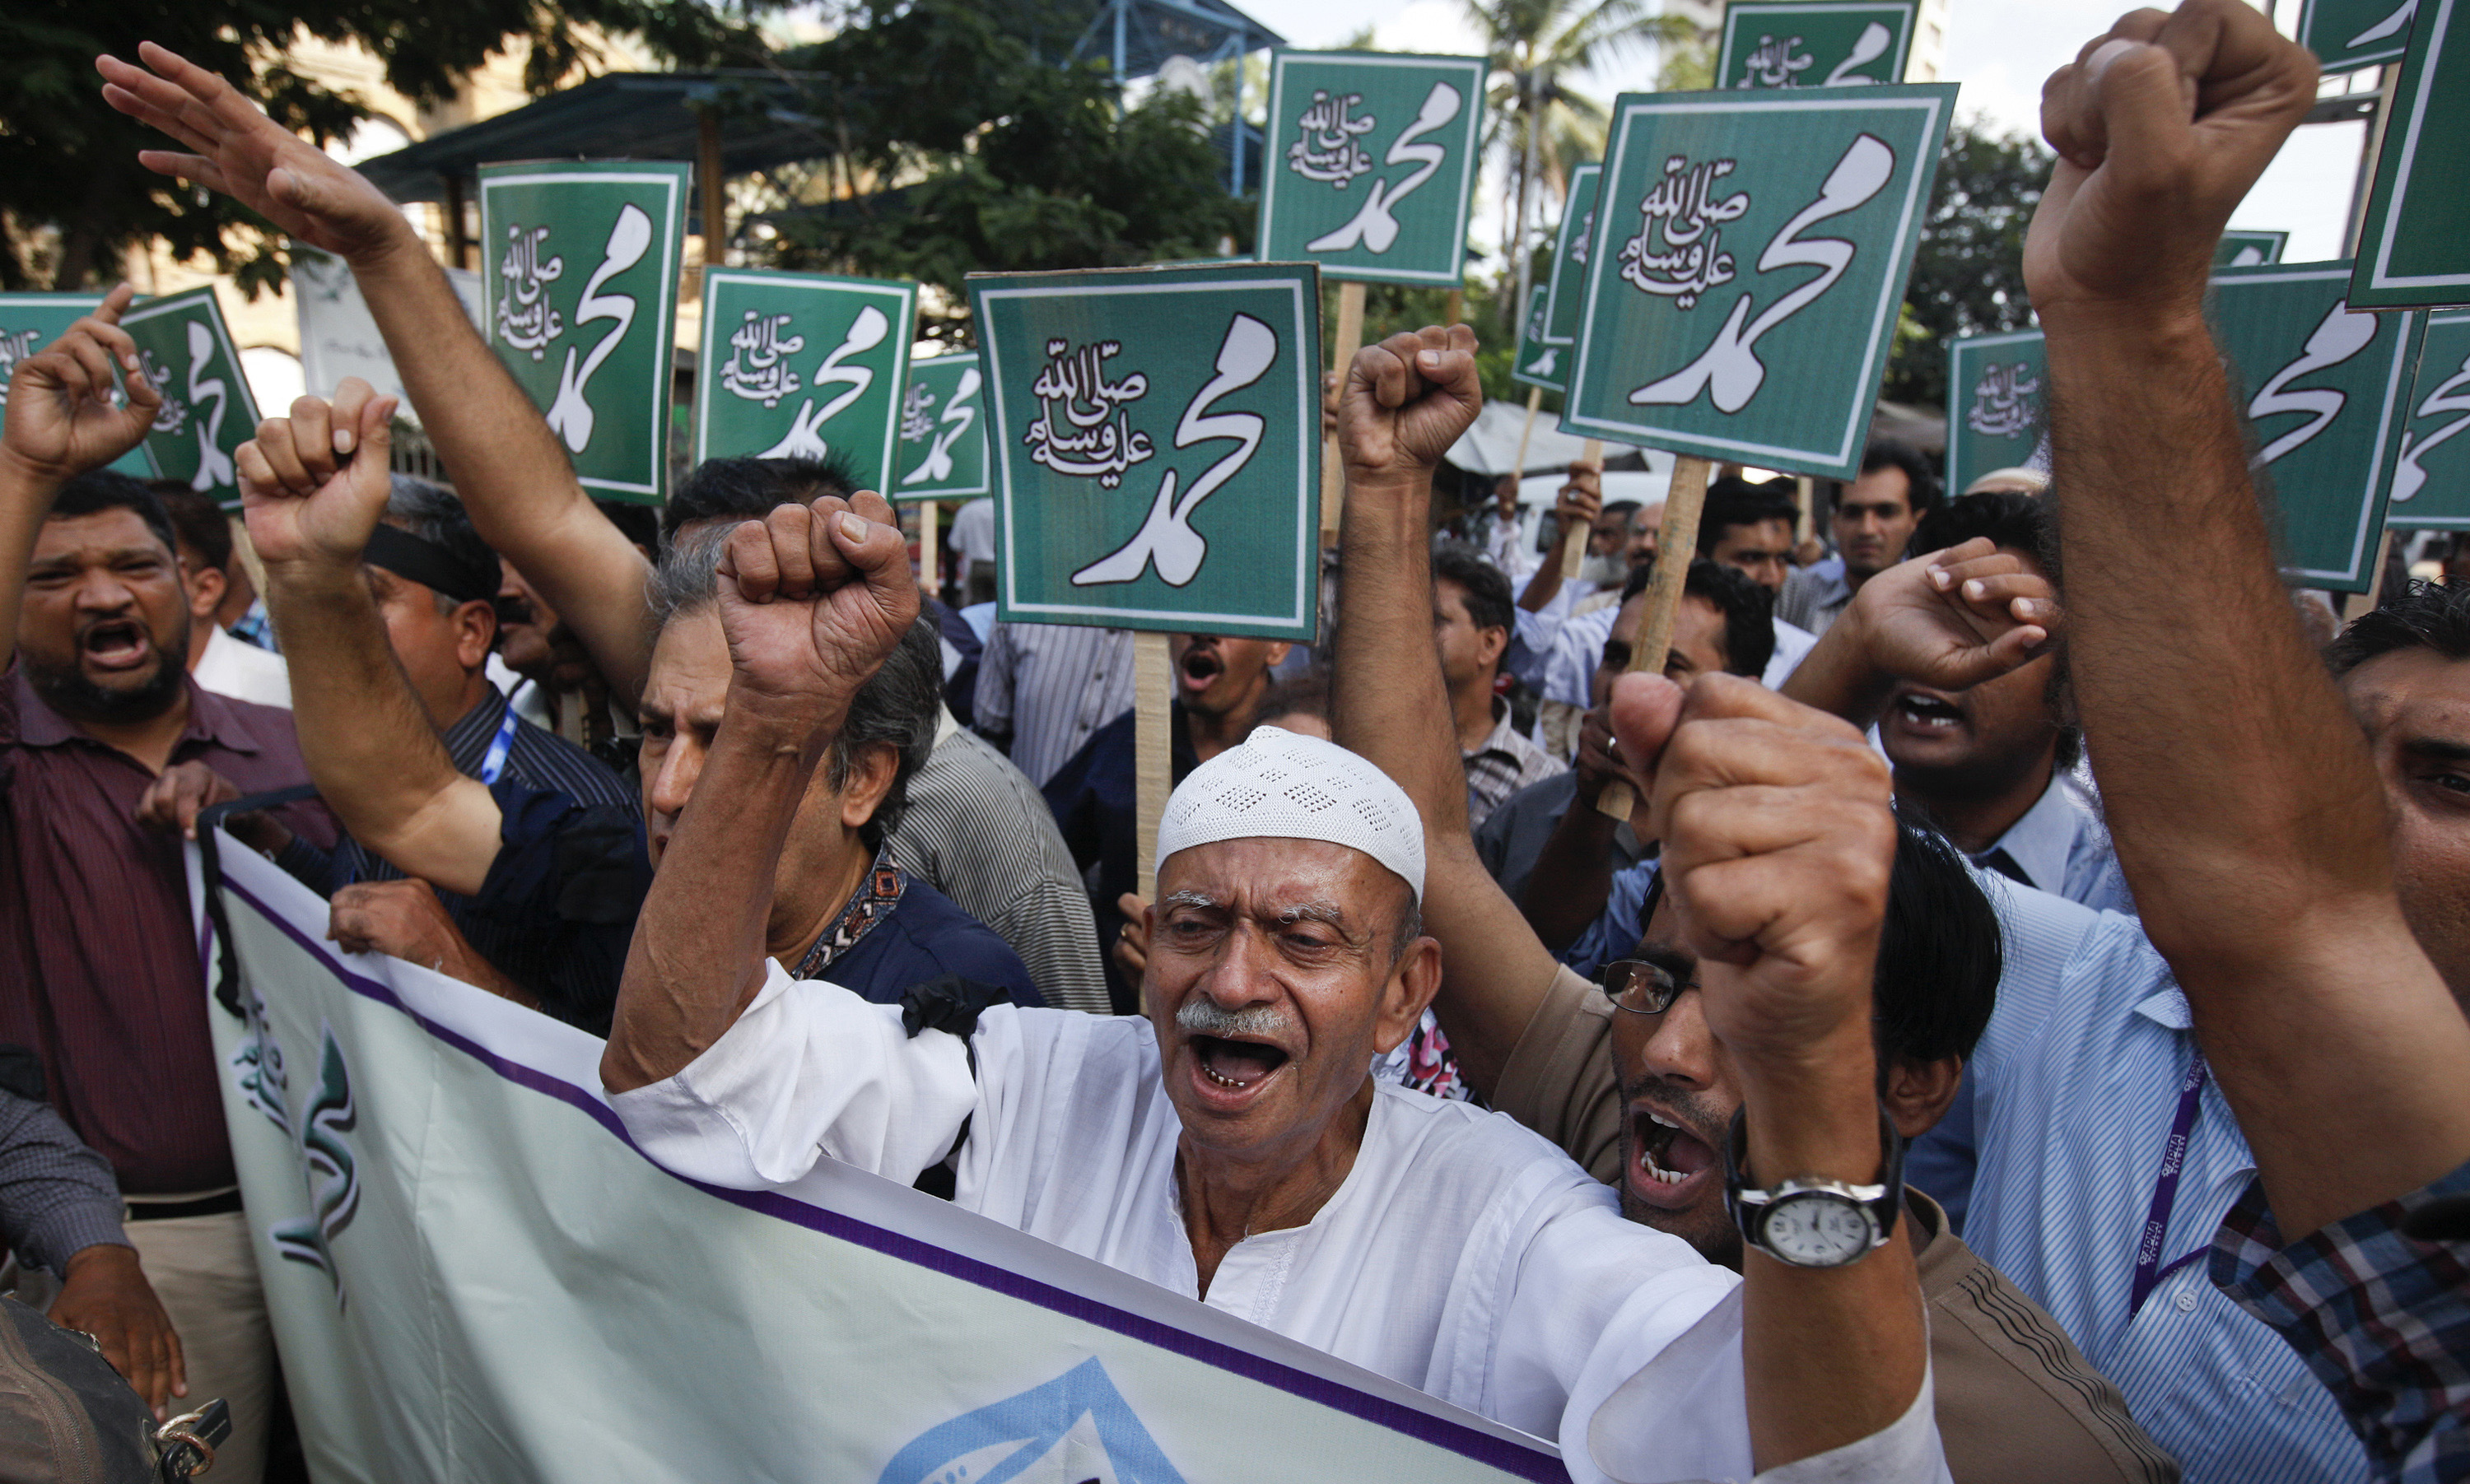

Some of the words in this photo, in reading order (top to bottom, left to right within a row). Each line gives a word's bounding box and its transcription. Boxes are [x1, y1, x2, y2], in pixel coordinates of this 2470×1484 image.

[1307, 81, 1461, 254] محمد
[1629, 133, 1895, 413] محمد
[901, 367, 981, 486] محمد
[1071, 312, 1278, 588] محمد
